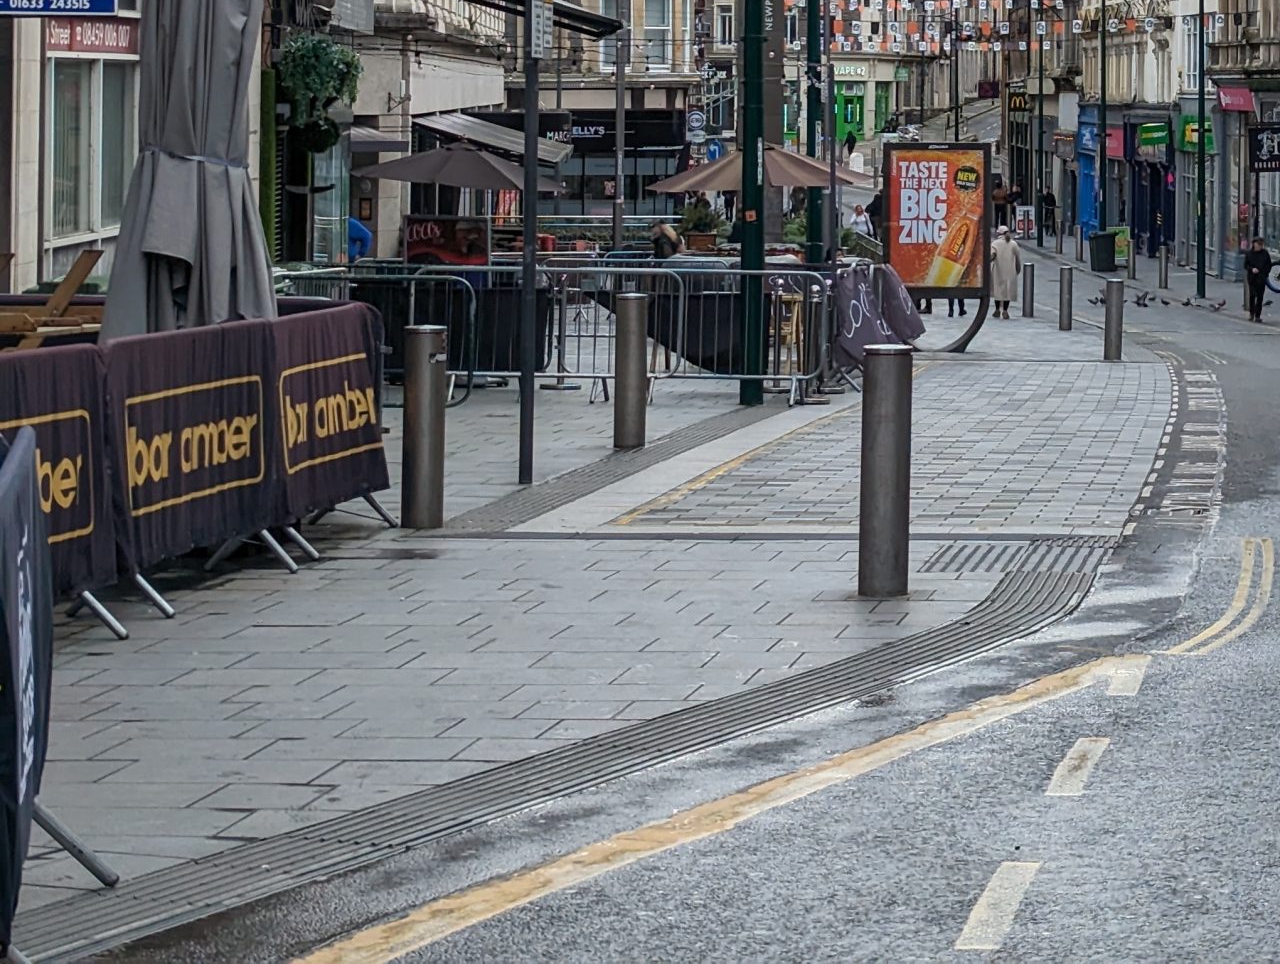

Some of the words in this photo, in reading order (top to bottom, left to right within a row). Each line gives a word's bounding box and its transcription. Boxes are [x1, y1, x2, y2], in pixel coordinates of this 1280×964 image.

[833, 66, 855, 75] VAPE
[899, 161, 948, 179] TASTE
[957, 171, 978, 182] NEW
[900, 179, 919, 189] THE
[921, 179, 948, 189] NEXT
[900, 189, 948, 220] BIG
[898, 220, 948, 245] ZING
[313, 380, 377, 440] amber
[127, 426, 172, 488] bar
[180, 412, 258, 475] amber
